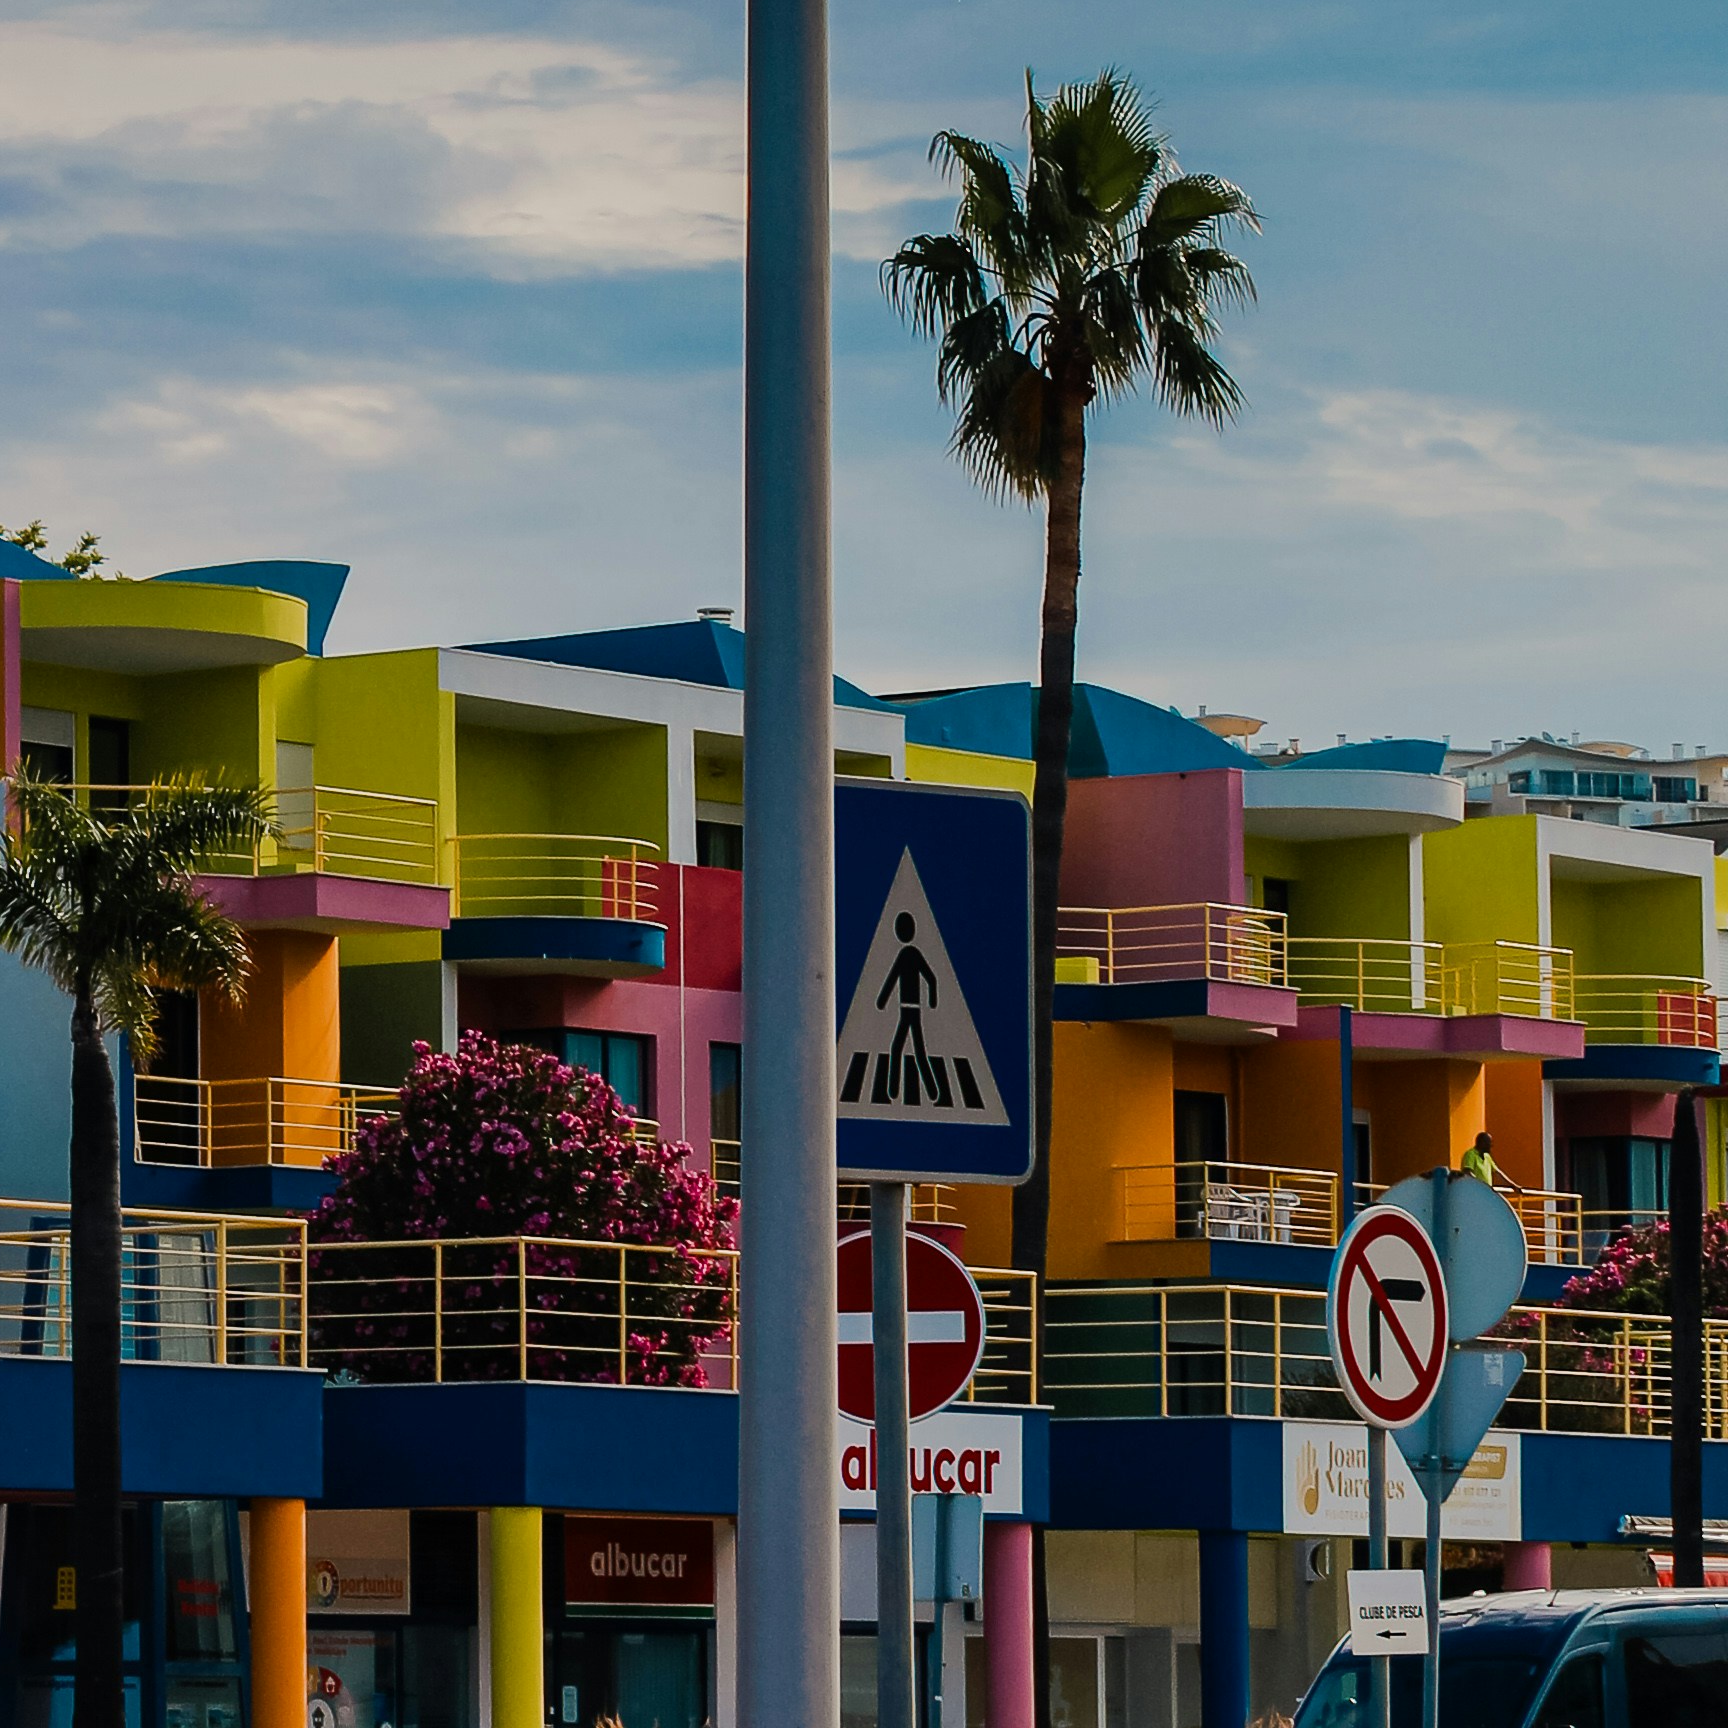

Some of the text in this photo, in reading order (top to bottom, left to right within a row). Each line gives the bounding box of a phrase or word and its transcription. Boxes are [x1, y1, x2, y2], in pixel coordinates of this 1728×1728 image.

[841, 1428, 1001, 1495] alucar
[590, 1542, 688, 1578] albucar
[1359, 1605, 1424, 1620] CLUBE DE PESCA
